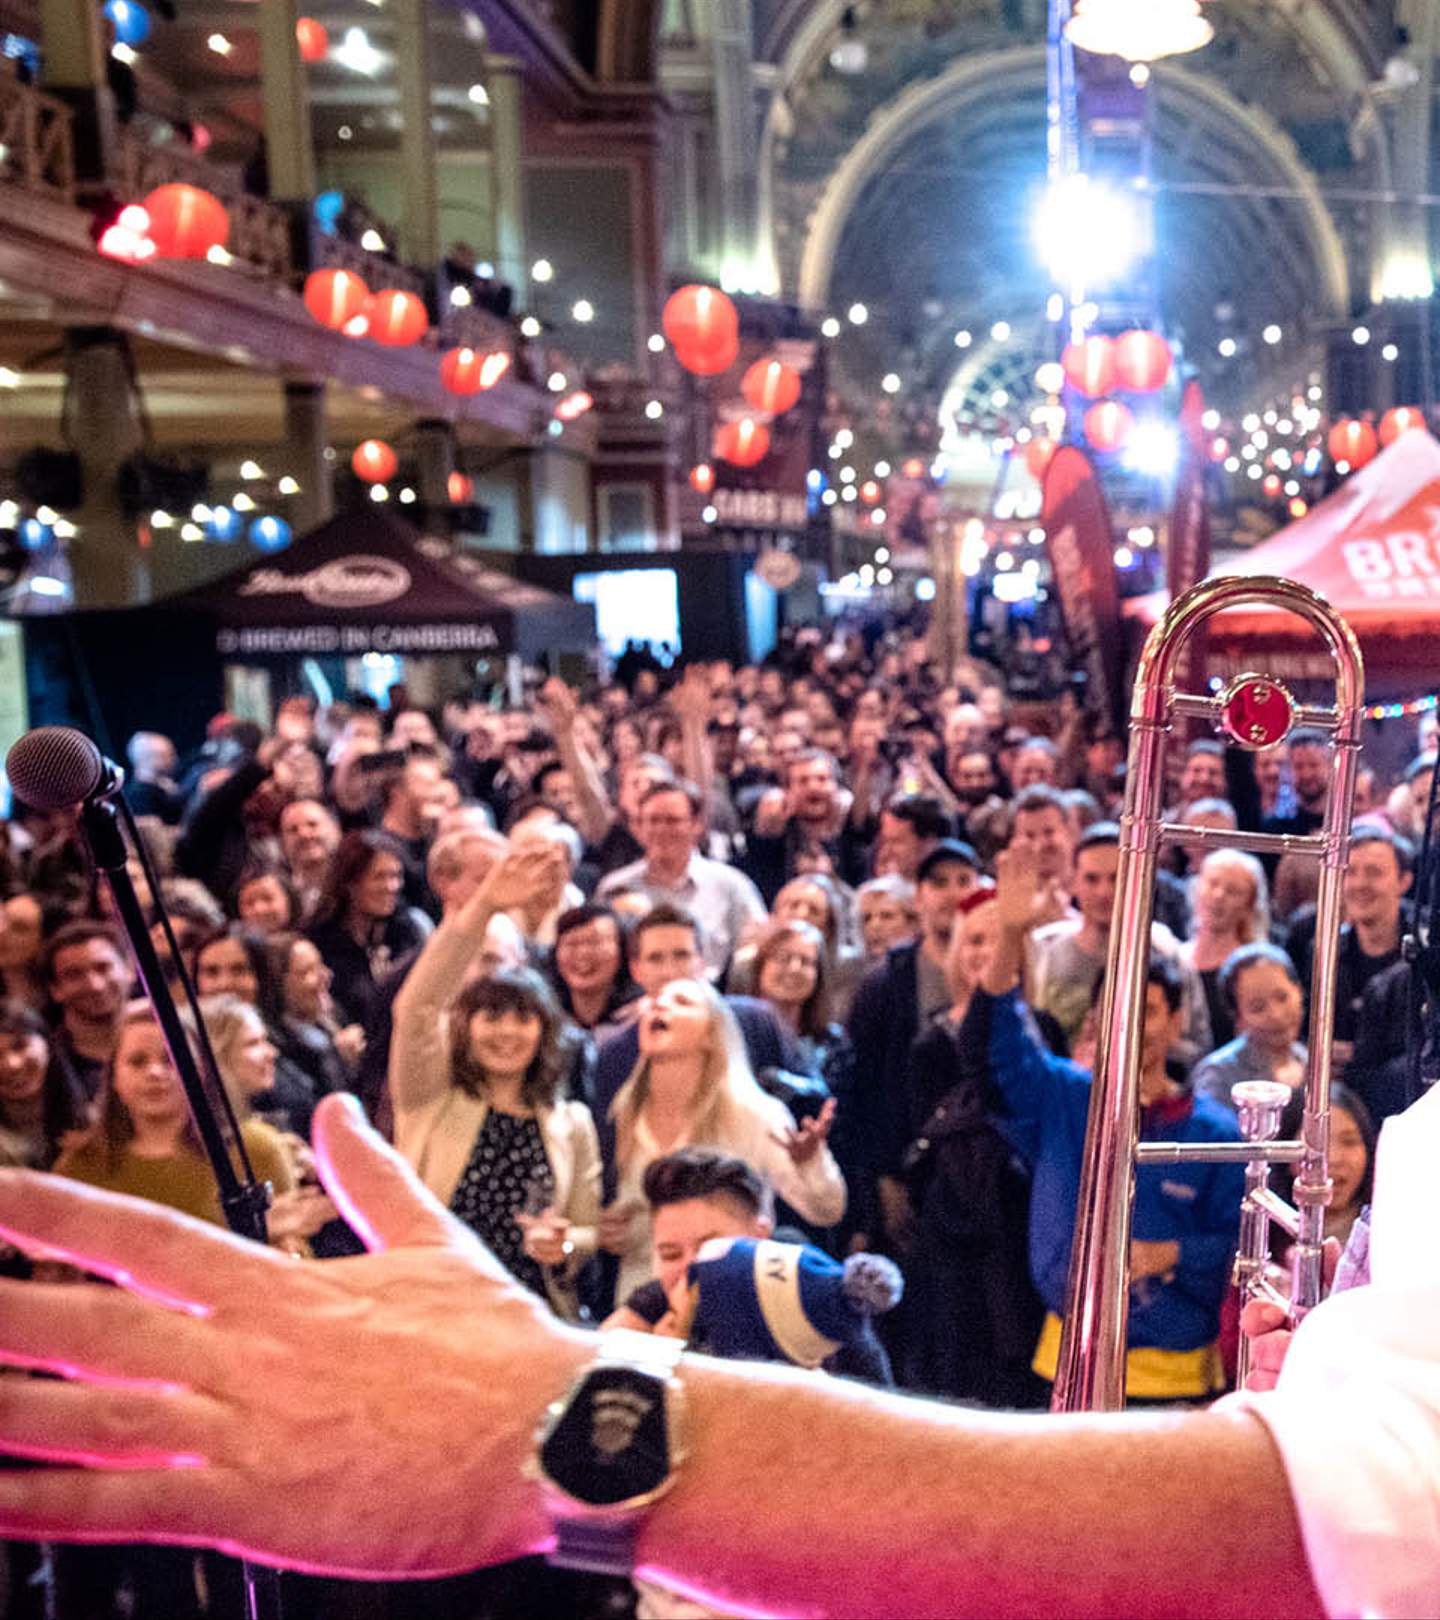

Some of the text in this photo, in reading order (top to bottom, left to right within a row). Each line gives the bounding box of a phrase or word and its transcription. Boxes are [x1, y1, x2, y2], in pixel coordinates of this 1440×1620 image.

[240, 625, 340, 651] BREWED
[341, 625, 371, 650] IN
[372, 623, 499, 650] CANBERRA
